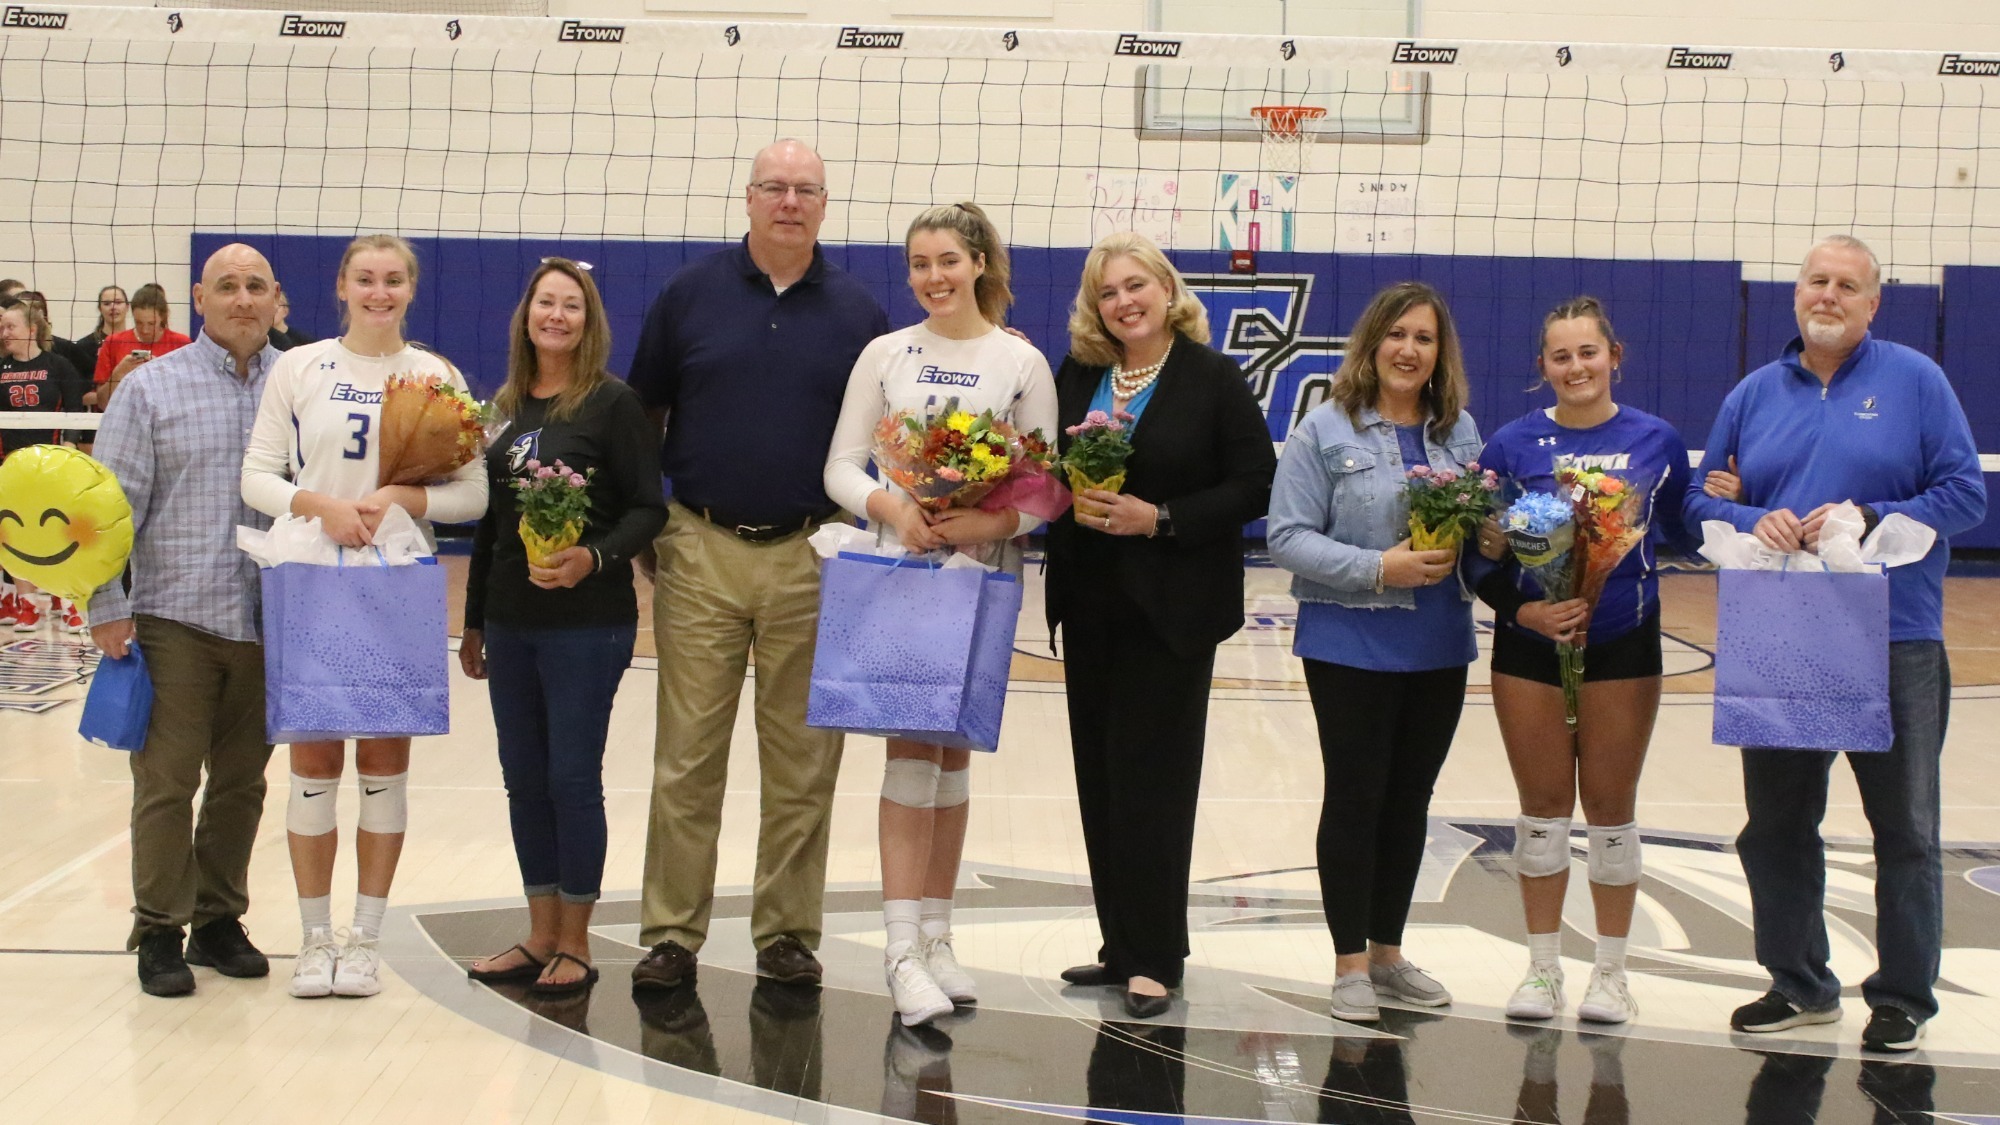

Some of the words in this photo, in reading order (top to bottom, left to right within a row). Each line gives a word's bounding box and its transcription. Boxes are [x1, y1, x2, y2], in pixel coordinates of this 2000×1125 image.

[4, 8, 65, 27] ETOWN
[282, 17, 343, 35] ETOWN
[561, 23, 622, 40] ETOWN
[840, 29, 901, 46] ETOWN
[1117, 36, 1178, 55] ETOWN
[1394, 44, 1455, 62] ETOWN
[1669, 49, 1729, 67] ETOWN
[918, 366, 977, 386] ETOWN
[9, 384, 40, 407] 26
[343, 412, 370, 460] 3
